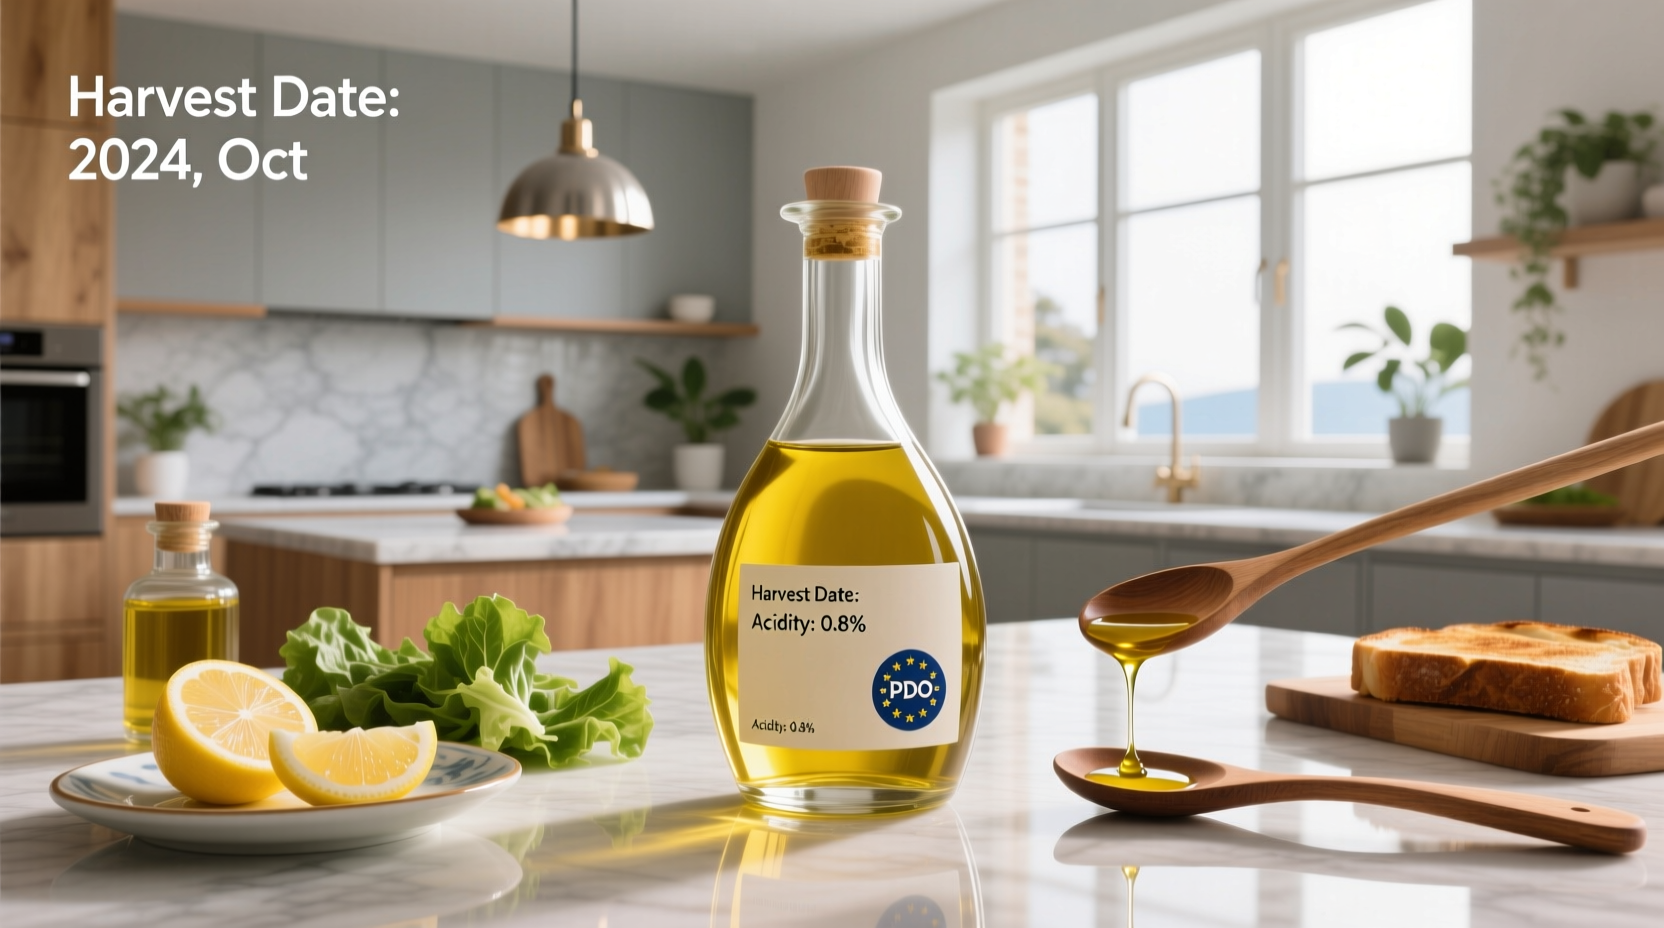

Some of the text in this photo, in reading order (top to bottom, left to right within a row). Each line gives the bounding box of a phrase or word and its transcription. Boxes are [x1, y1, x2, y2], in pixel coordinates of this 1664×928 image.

[752, 584, 859, 602] Harvest Date:
[751, 613, 867, 636] Acidity: 0.8%
[889, 680, 934, 699] PDO
